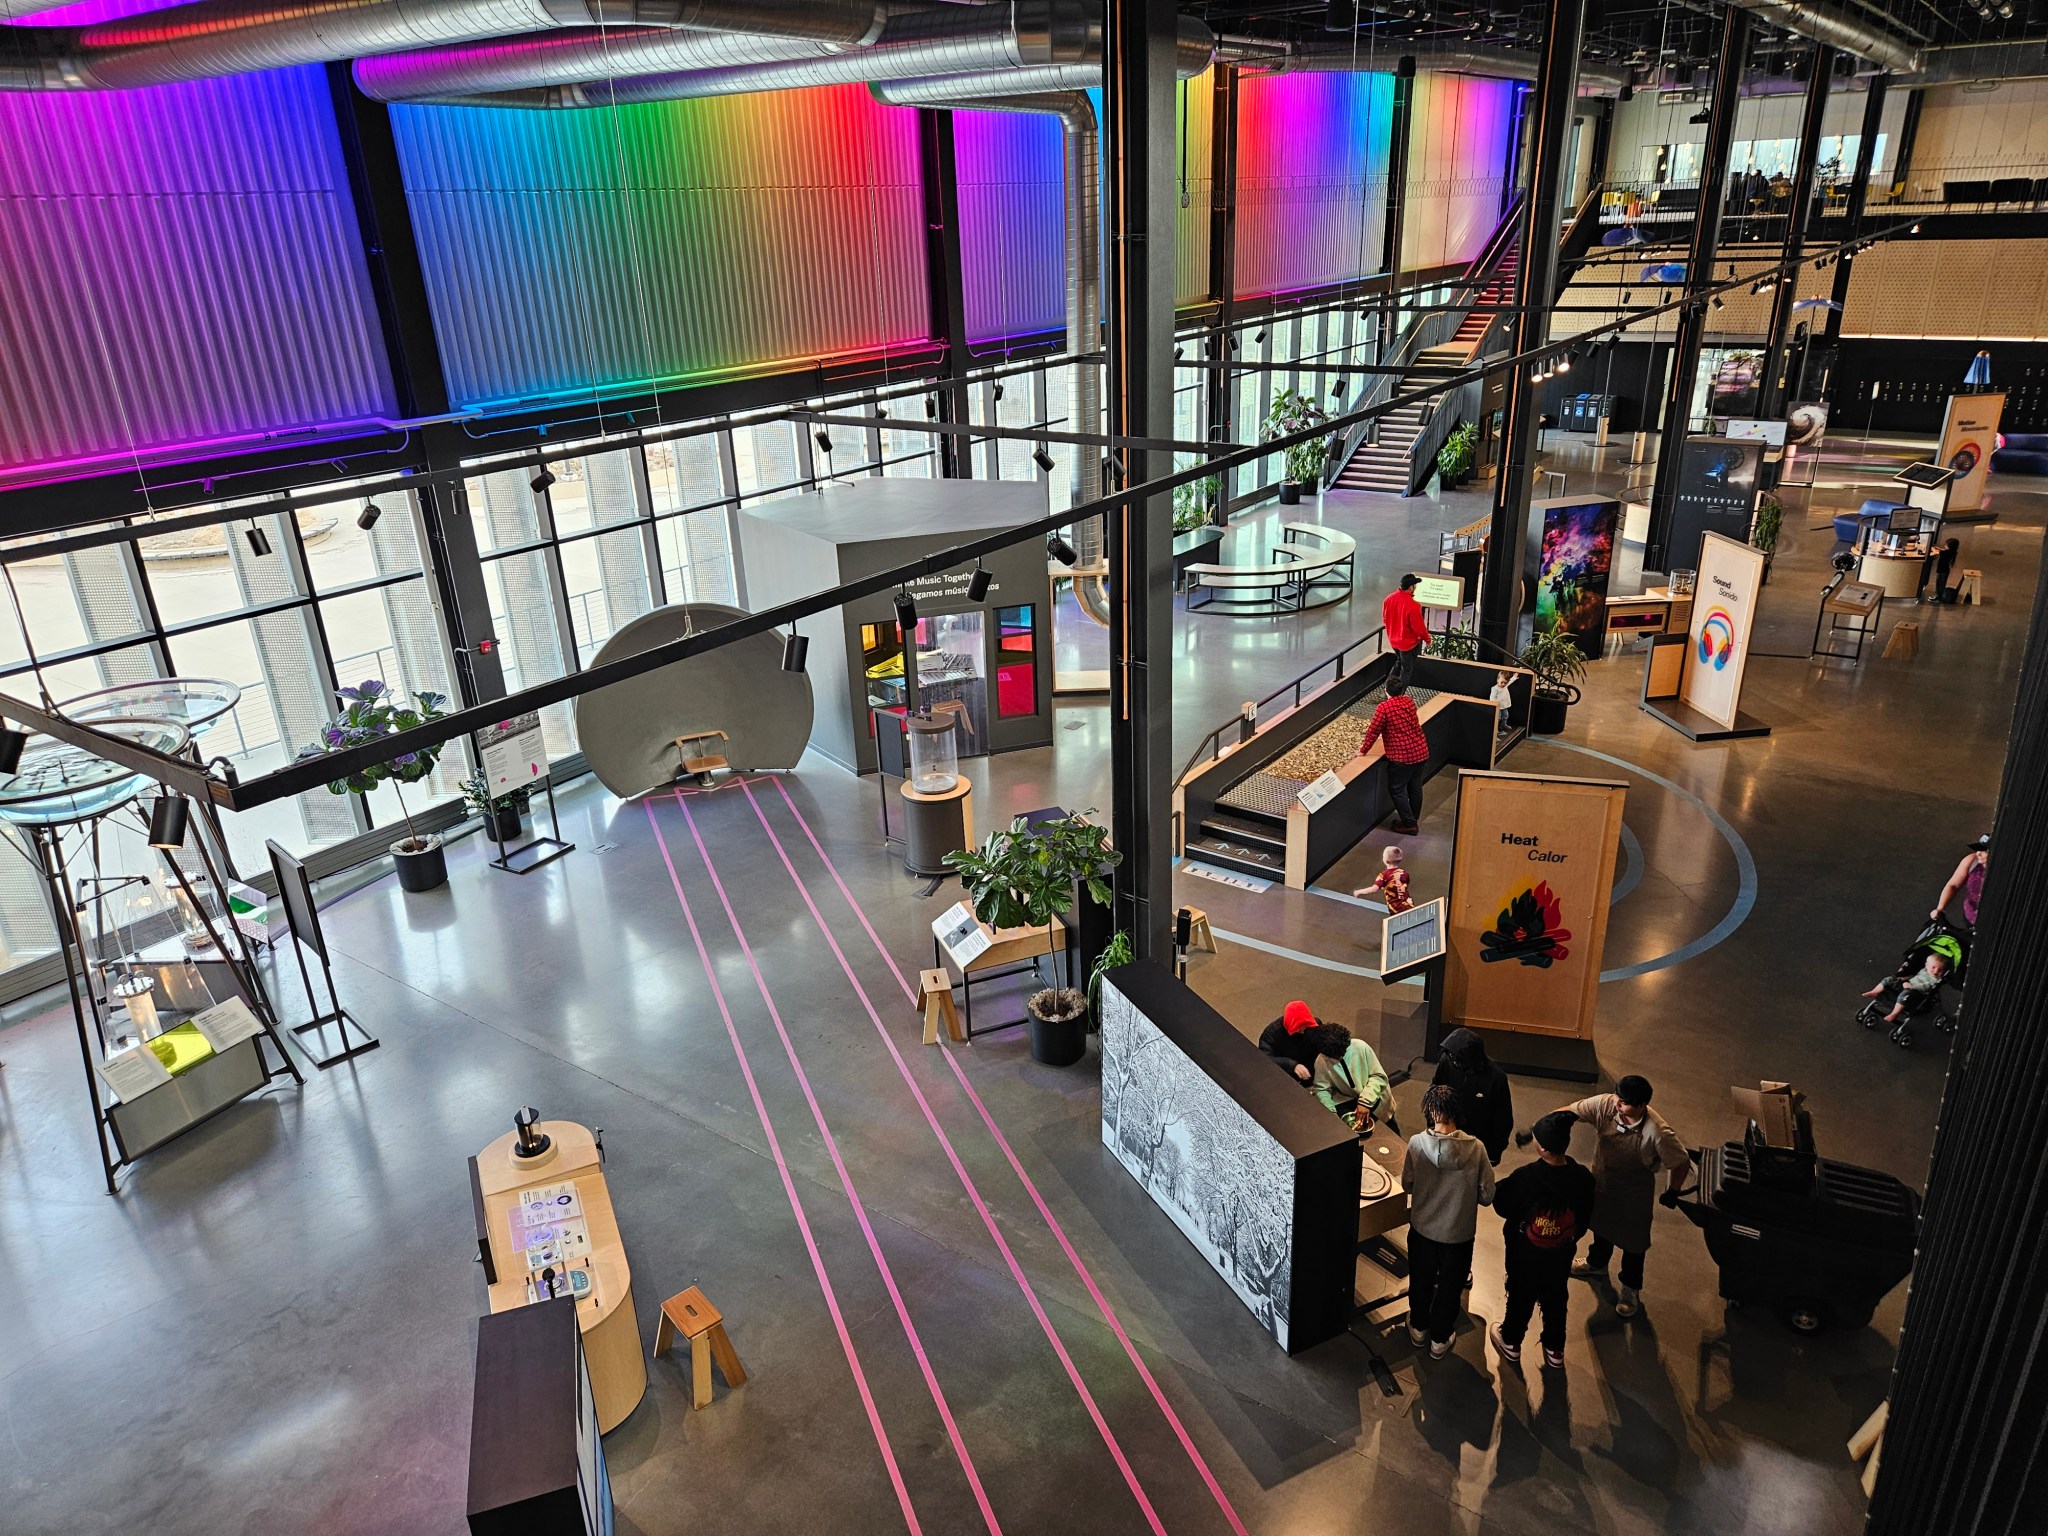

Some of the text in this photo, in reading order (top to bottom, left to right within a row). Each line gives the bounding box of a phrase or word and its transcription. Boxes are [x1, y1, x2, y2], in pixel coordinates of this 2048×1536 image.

[917, 576, 942, 586] Music
[943, 572, 974, 584] Togeth
[1712, 575, 1732, 589] Sound
[909, 589, 943, 600] agamos
[945, 586, 969, 596] músic
[1718, 588, 1738, 602] Sonido
[1501, 833, 1538, 846] Heat
[1528, 850, 1567, 863] Calor
